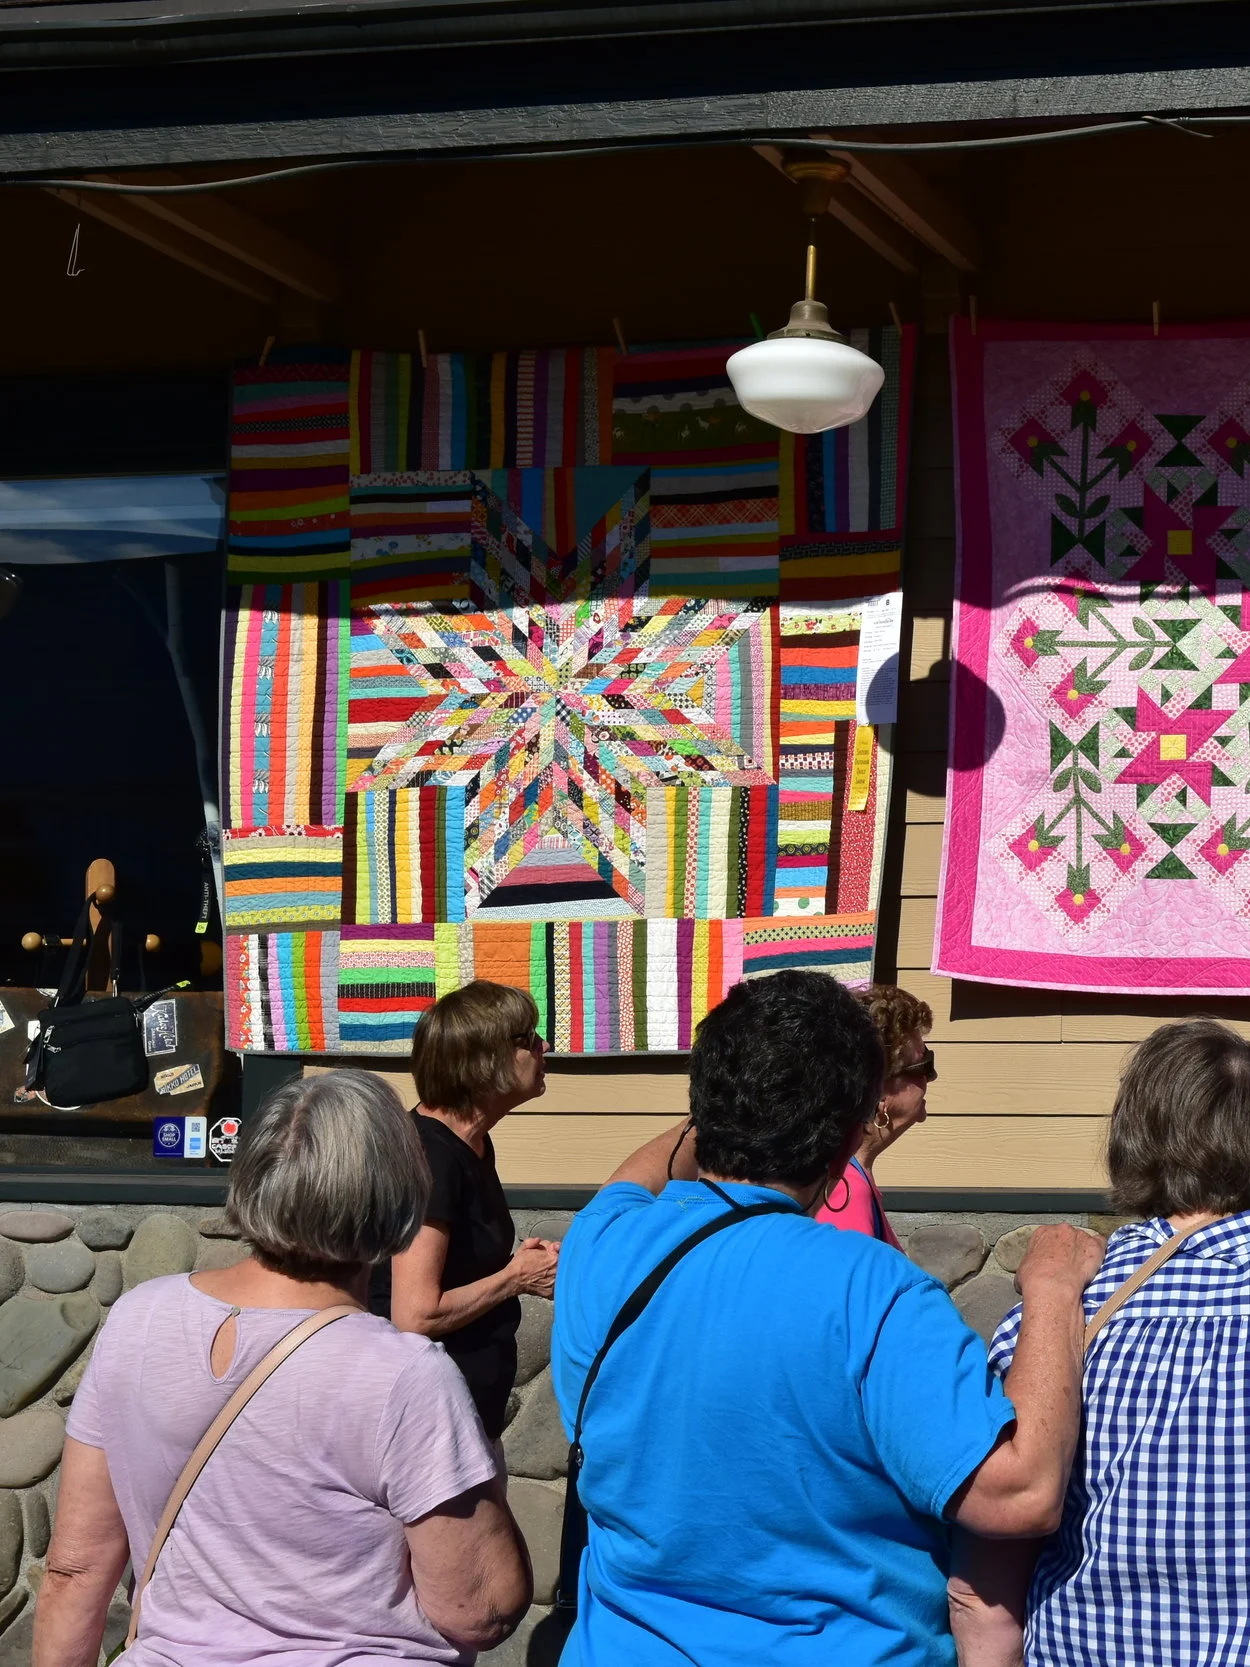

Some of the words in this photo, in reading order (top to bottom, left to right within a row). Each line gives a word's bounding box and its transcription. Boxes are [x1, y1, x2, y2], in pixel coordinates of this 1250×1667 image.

[201, 882, 209, 919] ANTI-THEFT
[160, 1078, 179, 1094] NIKKO
[180, 1067, 200, 1084] HOTEL
